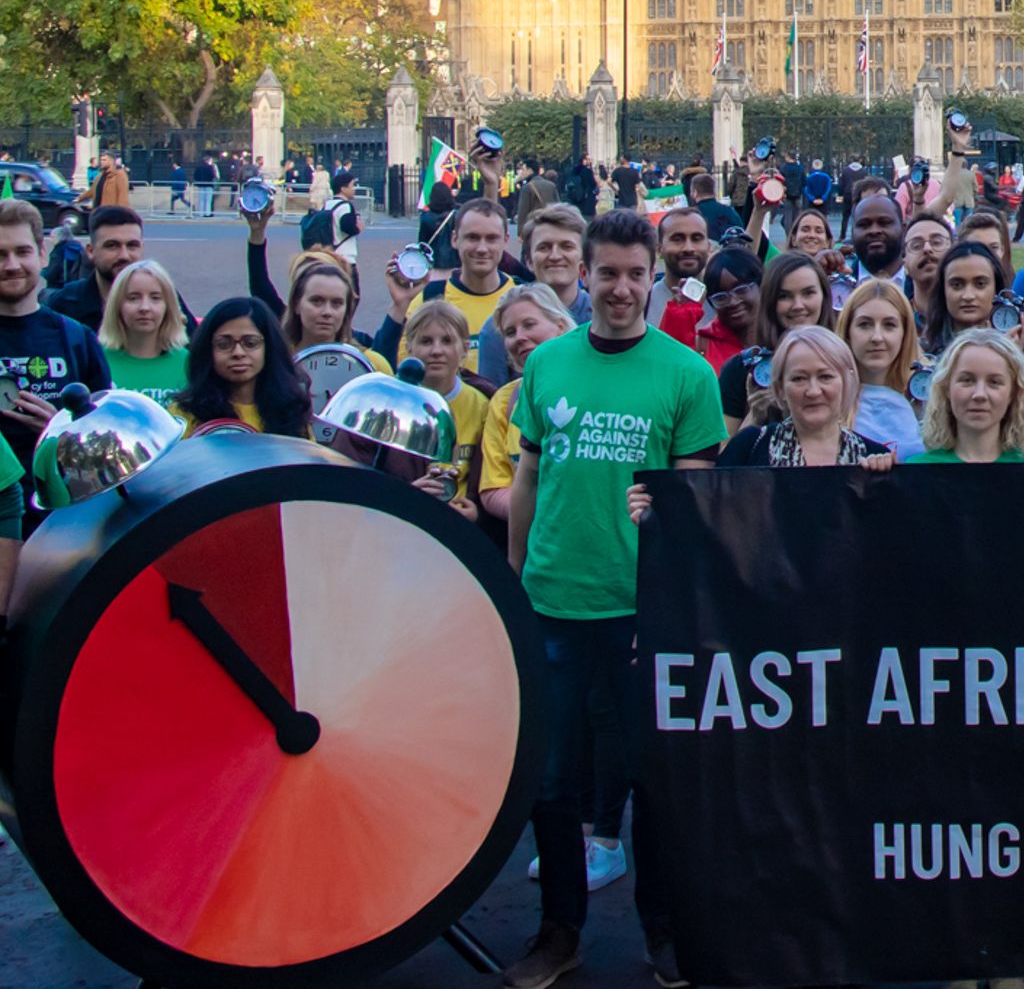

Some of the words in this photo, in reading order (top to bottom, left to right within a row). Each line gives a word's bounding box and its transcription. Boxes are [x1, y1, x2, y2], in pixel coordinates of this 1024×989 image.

[325, 356, 338, 366] 12
[580, 411, 652, 434] ACTION
[322, 428, 332, 437] 6
[578, 429, 648, 448] AGAINST
[575, 444, 647, 463] HUNGER
[655, 649, 842, 731] EAST
